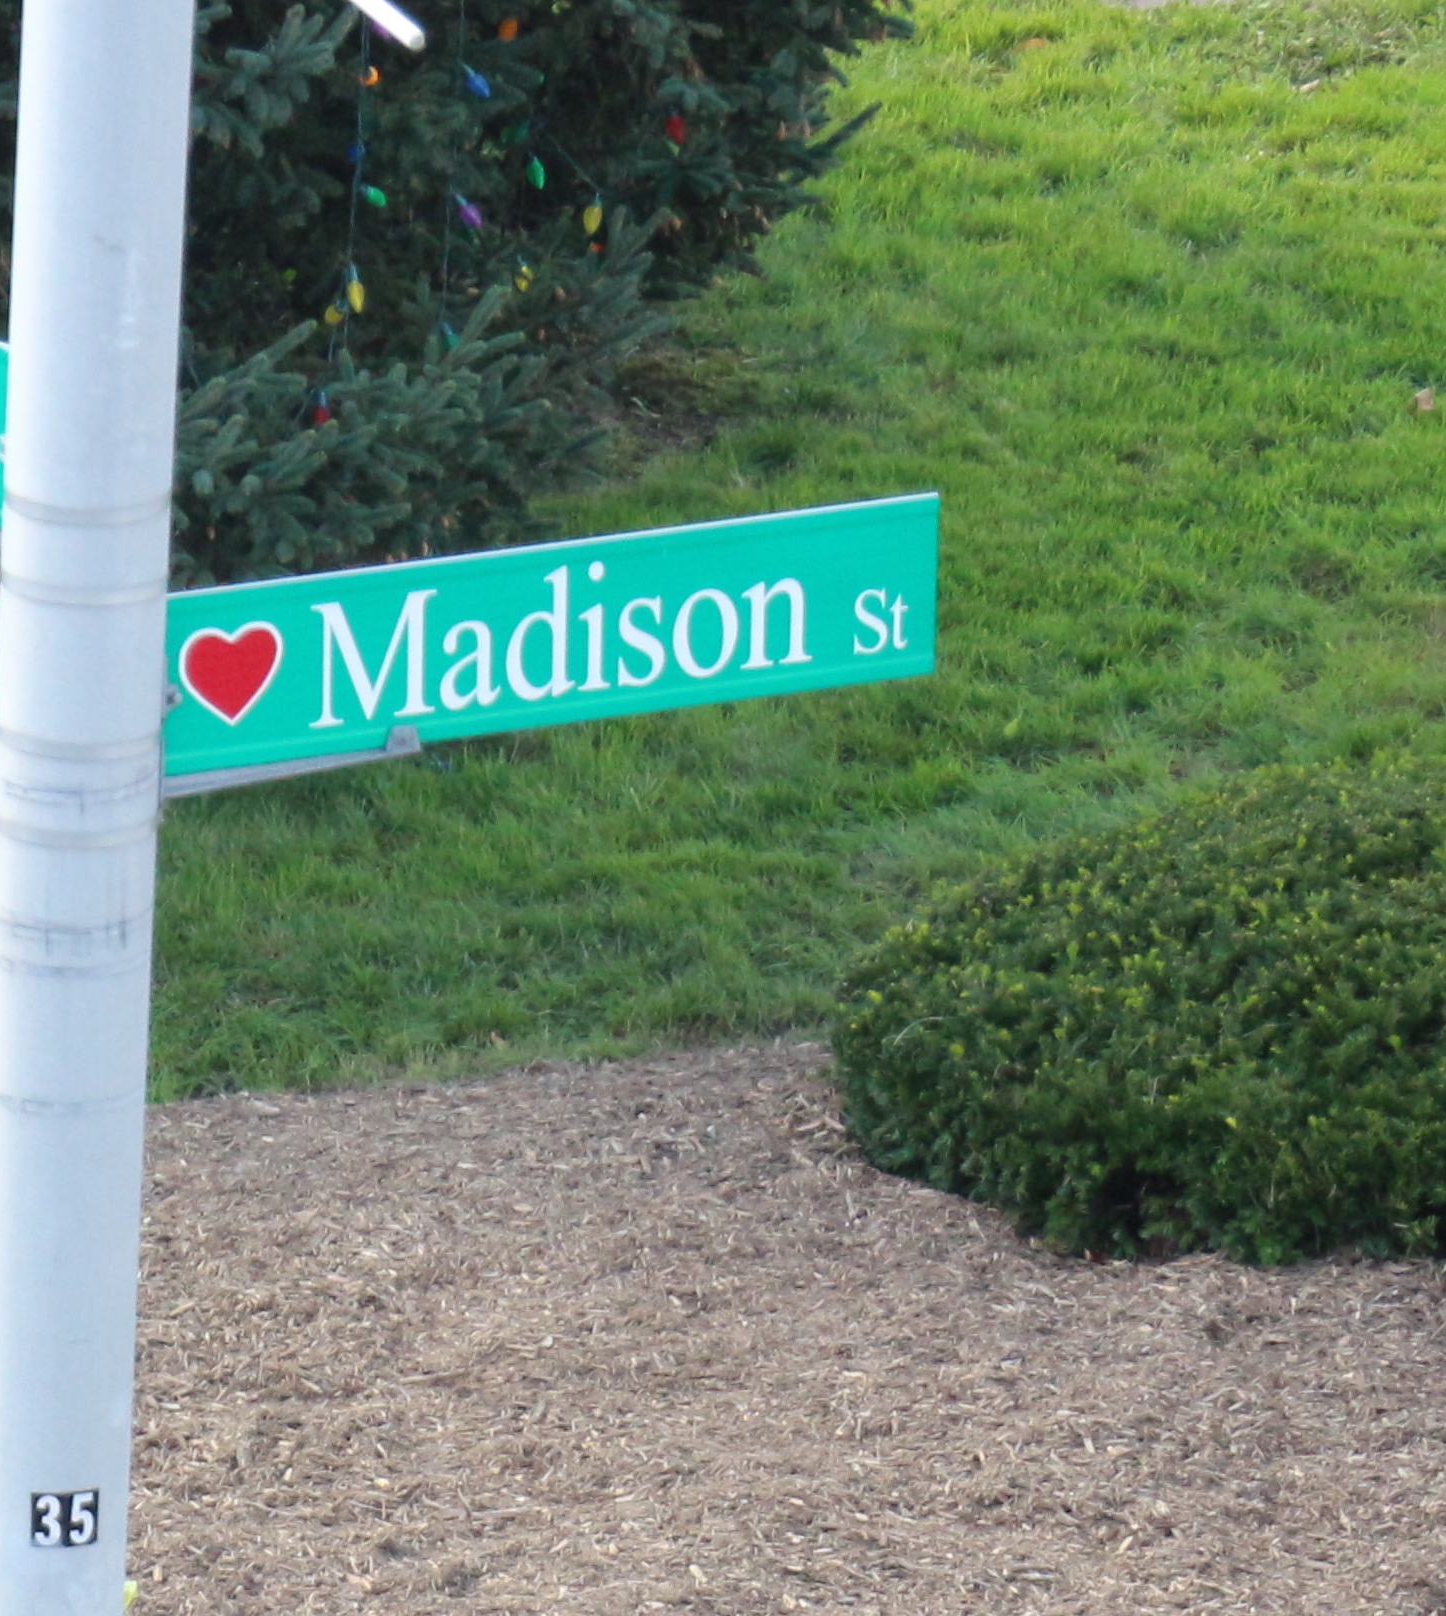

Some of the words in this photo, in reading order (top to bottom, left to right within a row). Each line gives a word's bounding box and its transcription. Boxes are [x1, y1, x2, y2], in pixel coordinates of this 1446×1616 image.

[308, 560, 813, 729] Madison
[852, 587, 909, 657] St
[33, 1492, 96, 1547] 35
